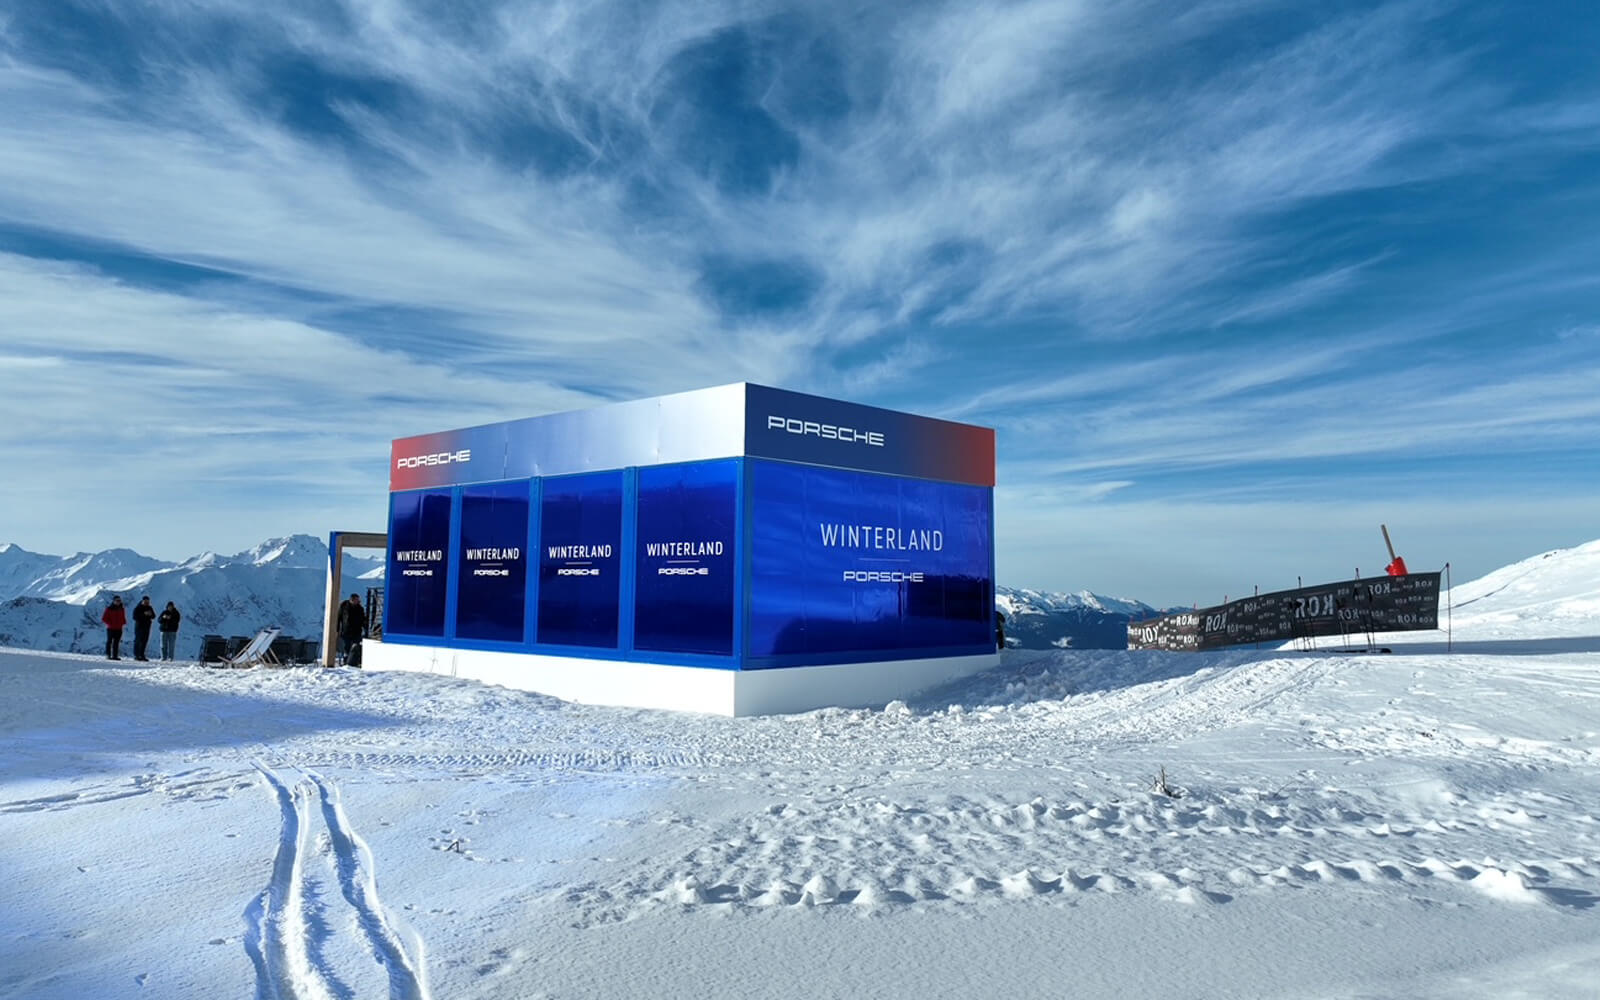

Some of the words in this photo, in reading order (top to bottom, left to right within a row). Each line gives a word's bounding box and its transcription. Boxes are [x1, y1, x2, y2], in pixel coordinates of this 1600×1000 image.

[767, 415, 885, 447] PORSCHE
[396, 448, 471, 470] PORSCHE
[820, 522, 944, 552] WINTERLAND
[396, 549, 443, 562] WINTERLAND
[466, 547, 520, 561] WINTERLAND
[548, 543, 613, 560] WINTERLAND
[646, 540, 724, 558] WINTERLAND
[402, 569, 433, 577] PORSCHE
[473, 568, 510, 576] PORSCHE
[557, 568, 600, 576] PORSCHE
[657, 567, 709, 576] PORSCHE
[843, 570, 924, 583] PORSCHE
